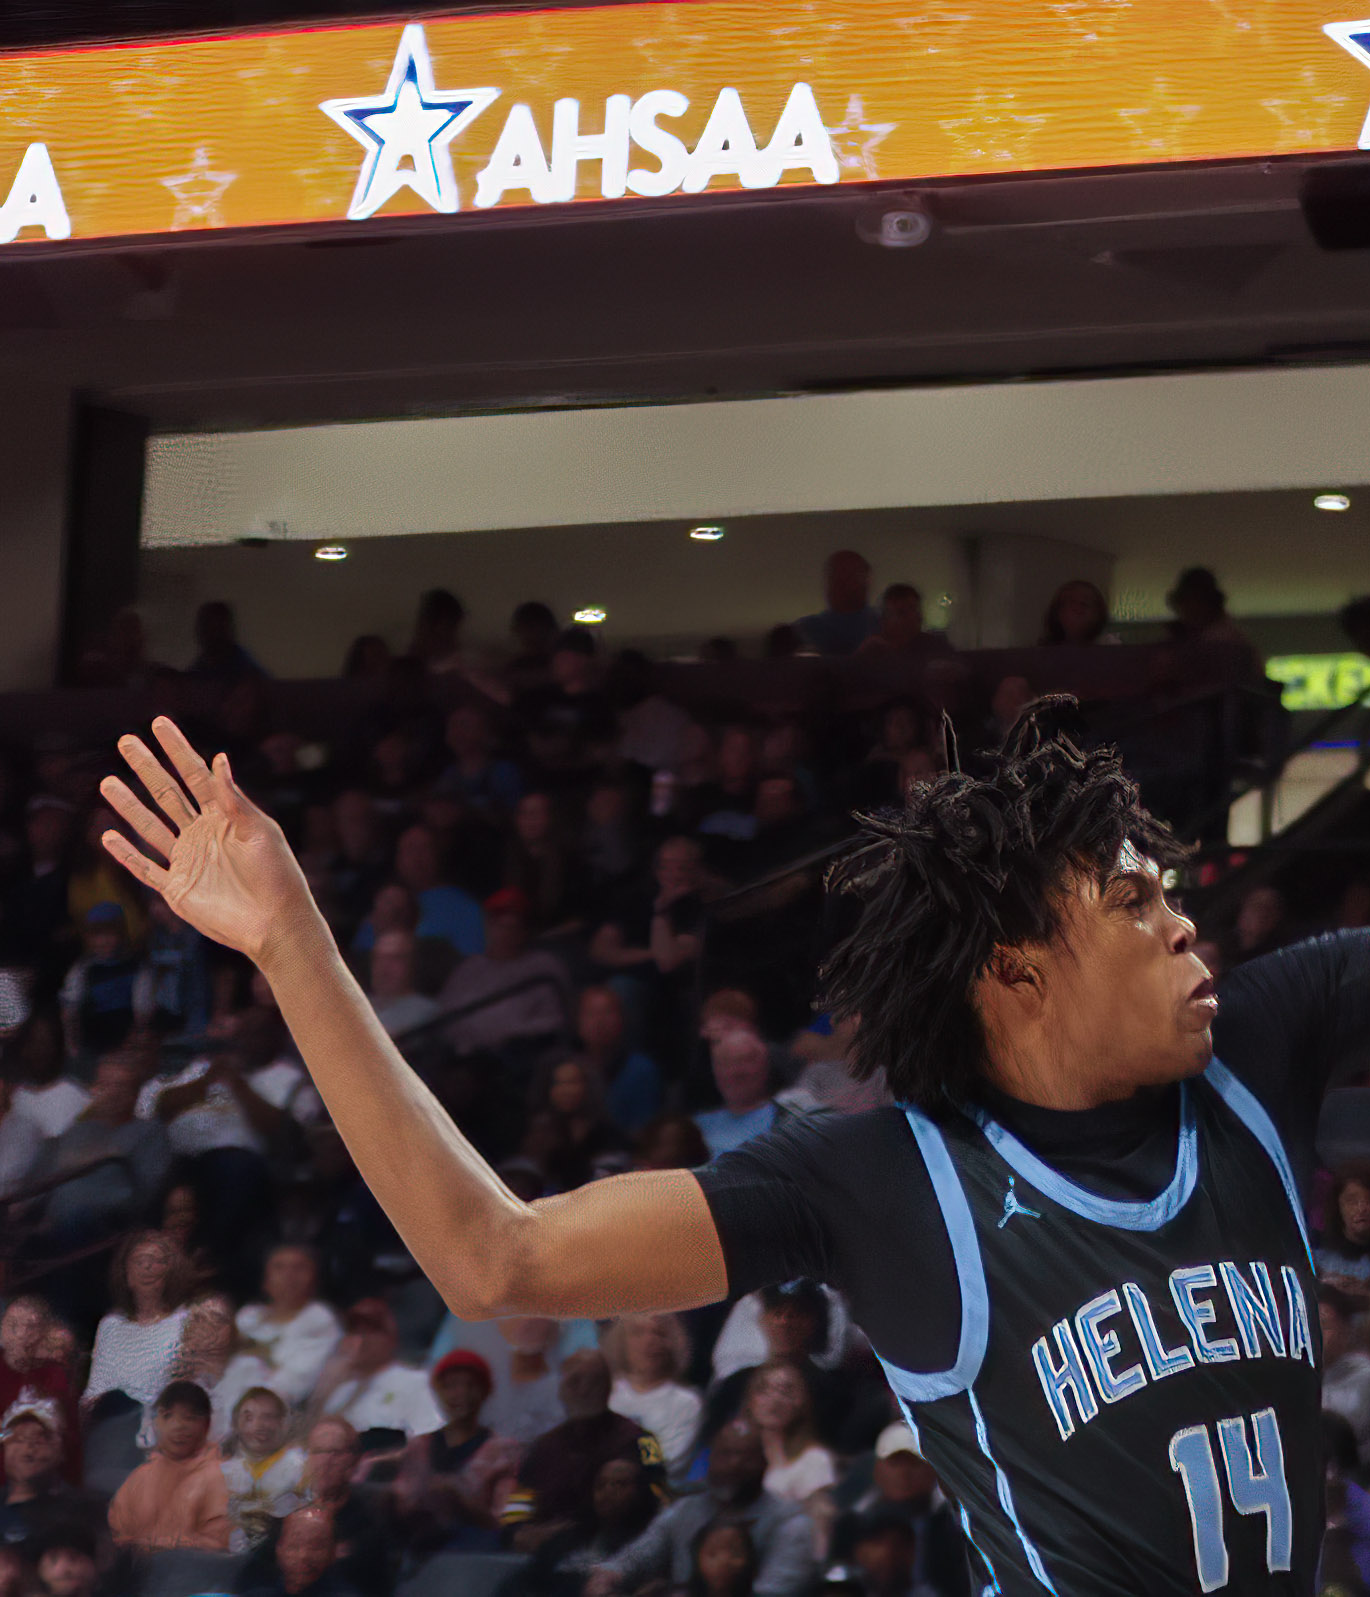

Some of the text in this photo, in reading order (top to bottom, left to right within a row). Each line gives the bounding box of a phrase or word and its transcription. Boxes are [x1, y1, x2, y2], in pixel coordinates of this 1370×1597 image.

[474, 82, 841, 209] AHSAA
[1031, 1261, 1315, 1442] HELENA
[1168, 1406, 1293, 1594] 14
